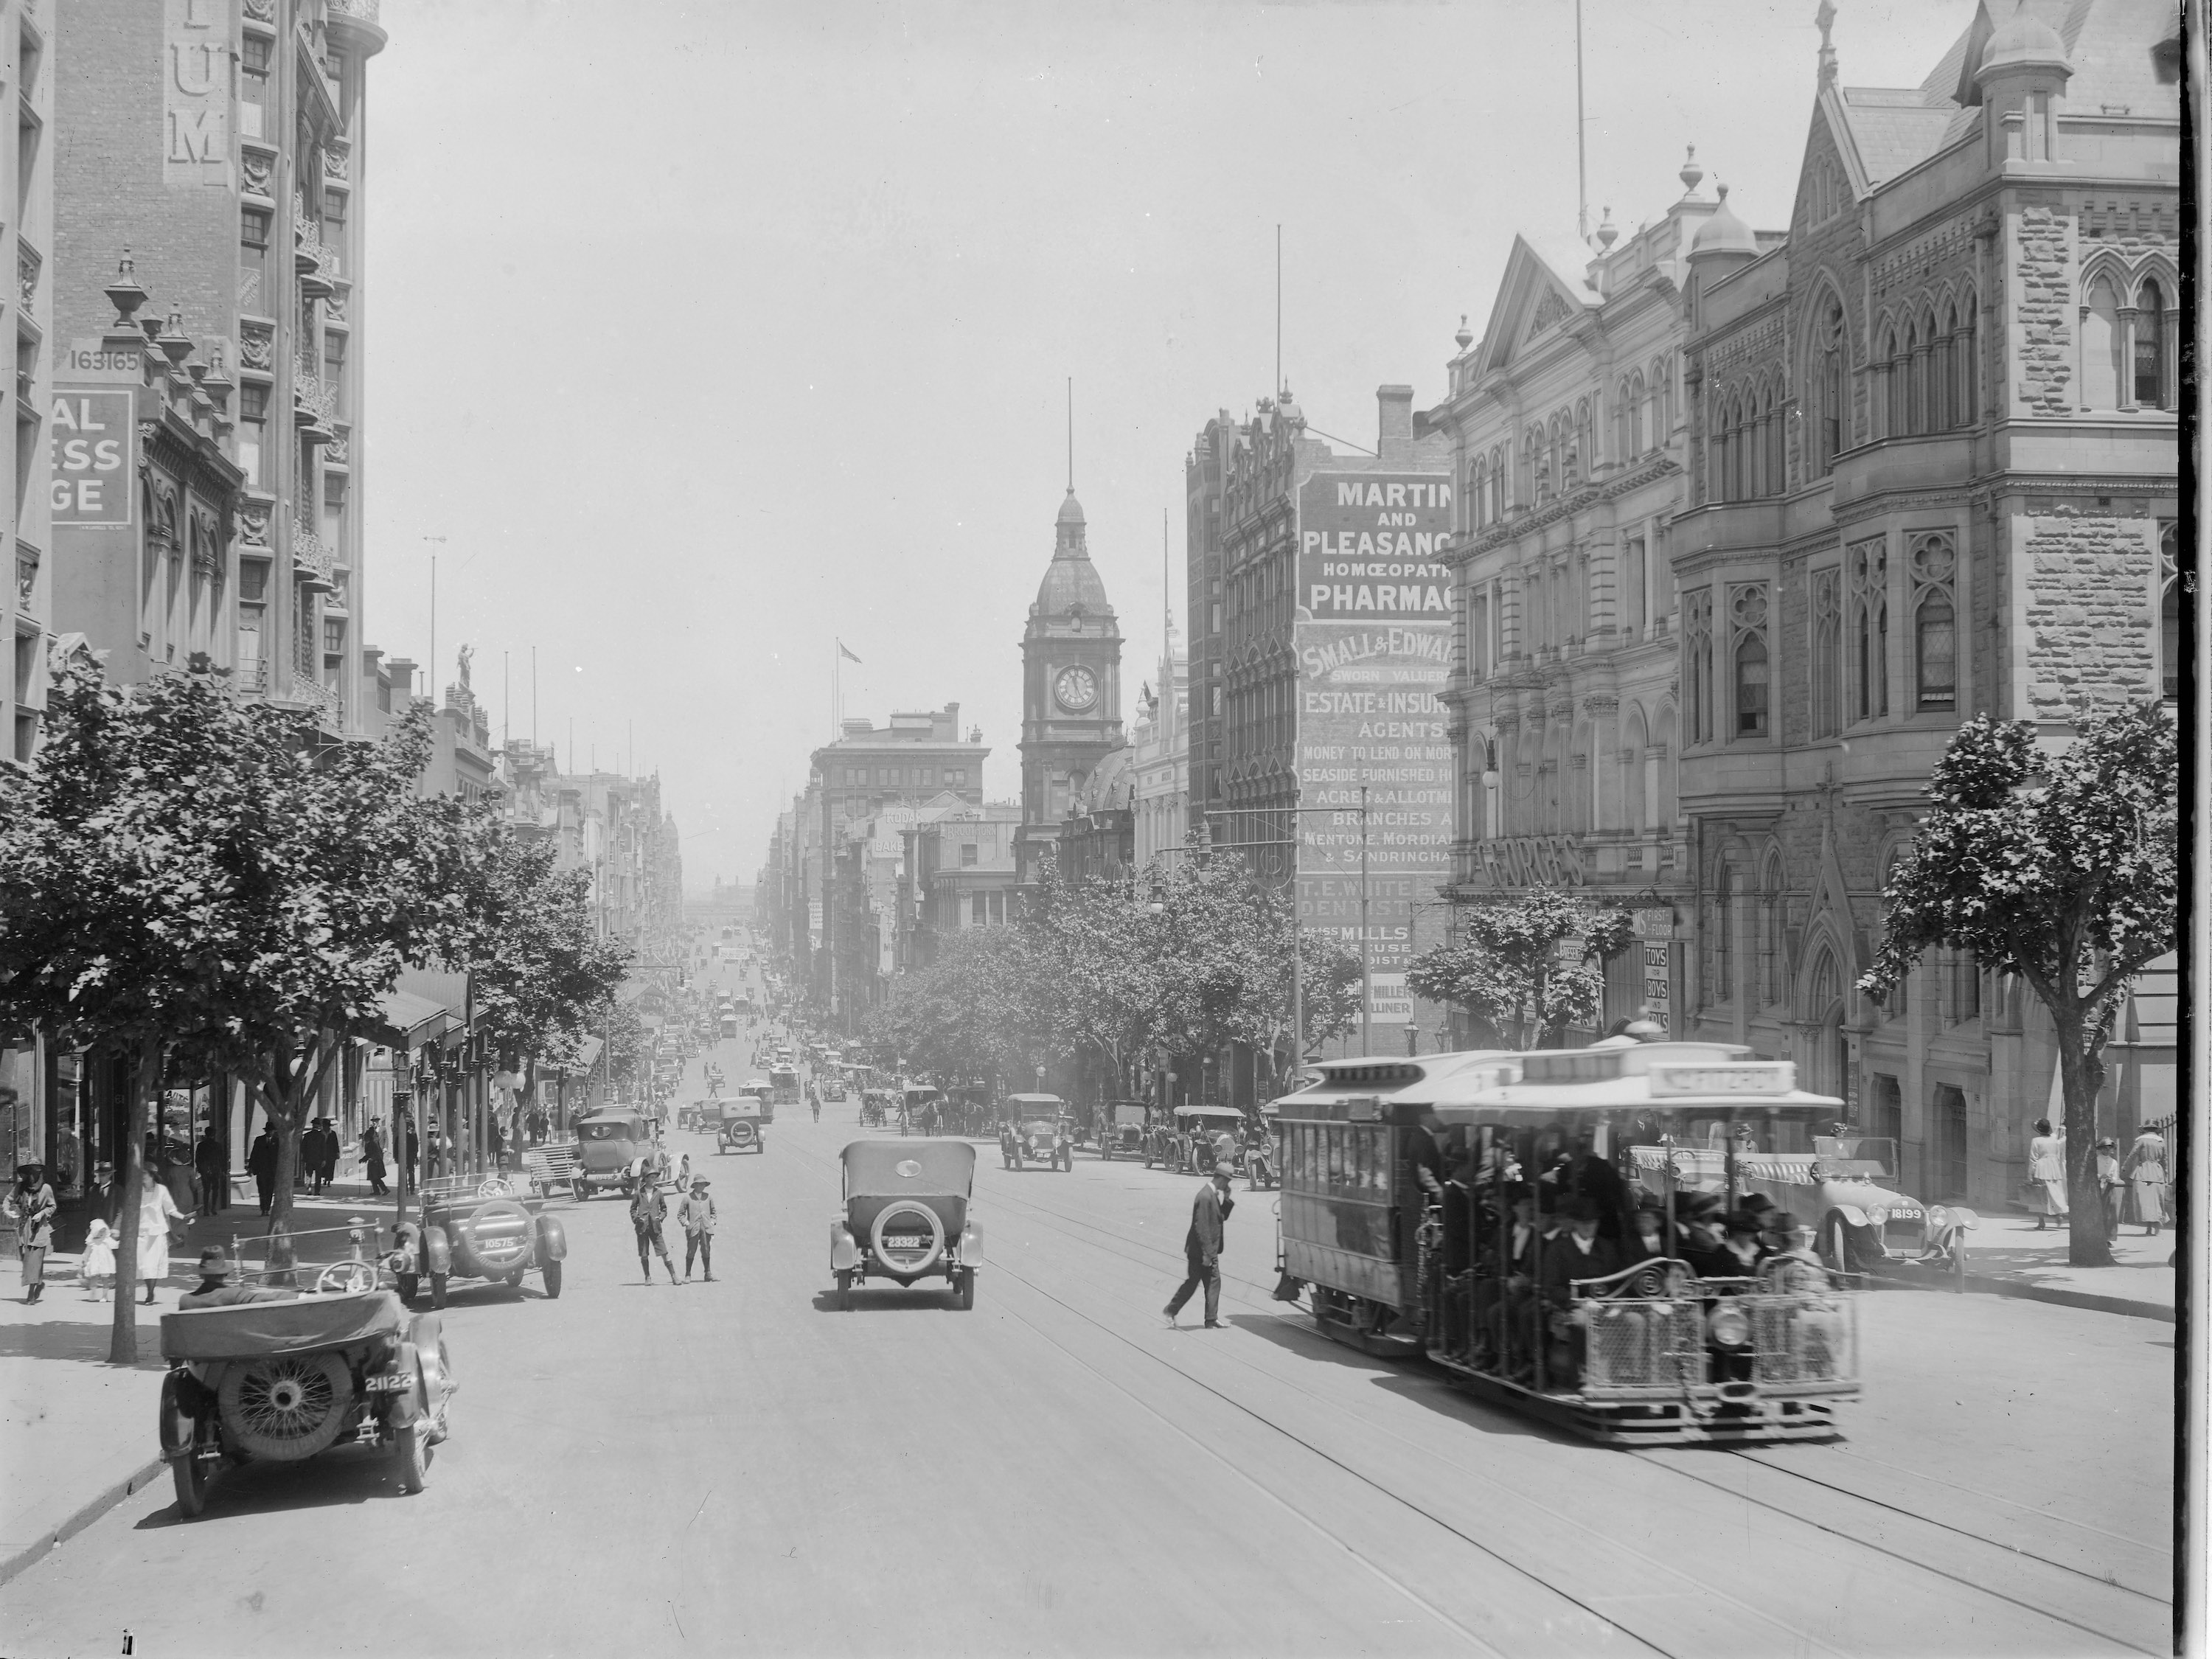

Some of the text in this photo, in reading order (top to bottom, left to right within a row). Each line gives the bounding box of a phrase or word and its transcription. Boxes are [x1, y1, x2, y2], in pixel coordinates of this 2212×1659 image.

[1377, 512, 1416, 526] AND
[1302, 633, 1377, 679] SMALL
[1375, 636, 1388, 653] &
[1332, 670, 1380, 682] SWORN
[1305, 692, 1376, 713] ESTATE
[1378, 698, 1385, 709] &
[1357, 722, 1444, 738] AGENTS
[1304, 746, 1346, 760] MONEY
[1351, 747, 1366, 760] TO
[1371, 746, 1399, 760] LEND
[1405, 747, 1422, 760] ON
[1302, 768, 1357, 782] SEASIDE
[1363, 768, 1434, 782] FURNISHED
[1316, 790, 1371, 804] ACRES
[1374, 793, 1383, 804] &
[886, 812, 922, 824] KODAK
[1332, 813, 1432, 826] BRANCHES
[1326, 852, 1335, 863] &
[1477, 834, 1584, 886] GEORGES
[1341, 927, 1408, 940] MILLS
[1646, 947, 1667, 966] TOYS
[1647, 979, 1668, 998] BOYS
[1892, 1208, 1921, 1219] 18199
[484, 1237, 515, 1249] 10575
[365, 1374, 411, 1392] 21122
